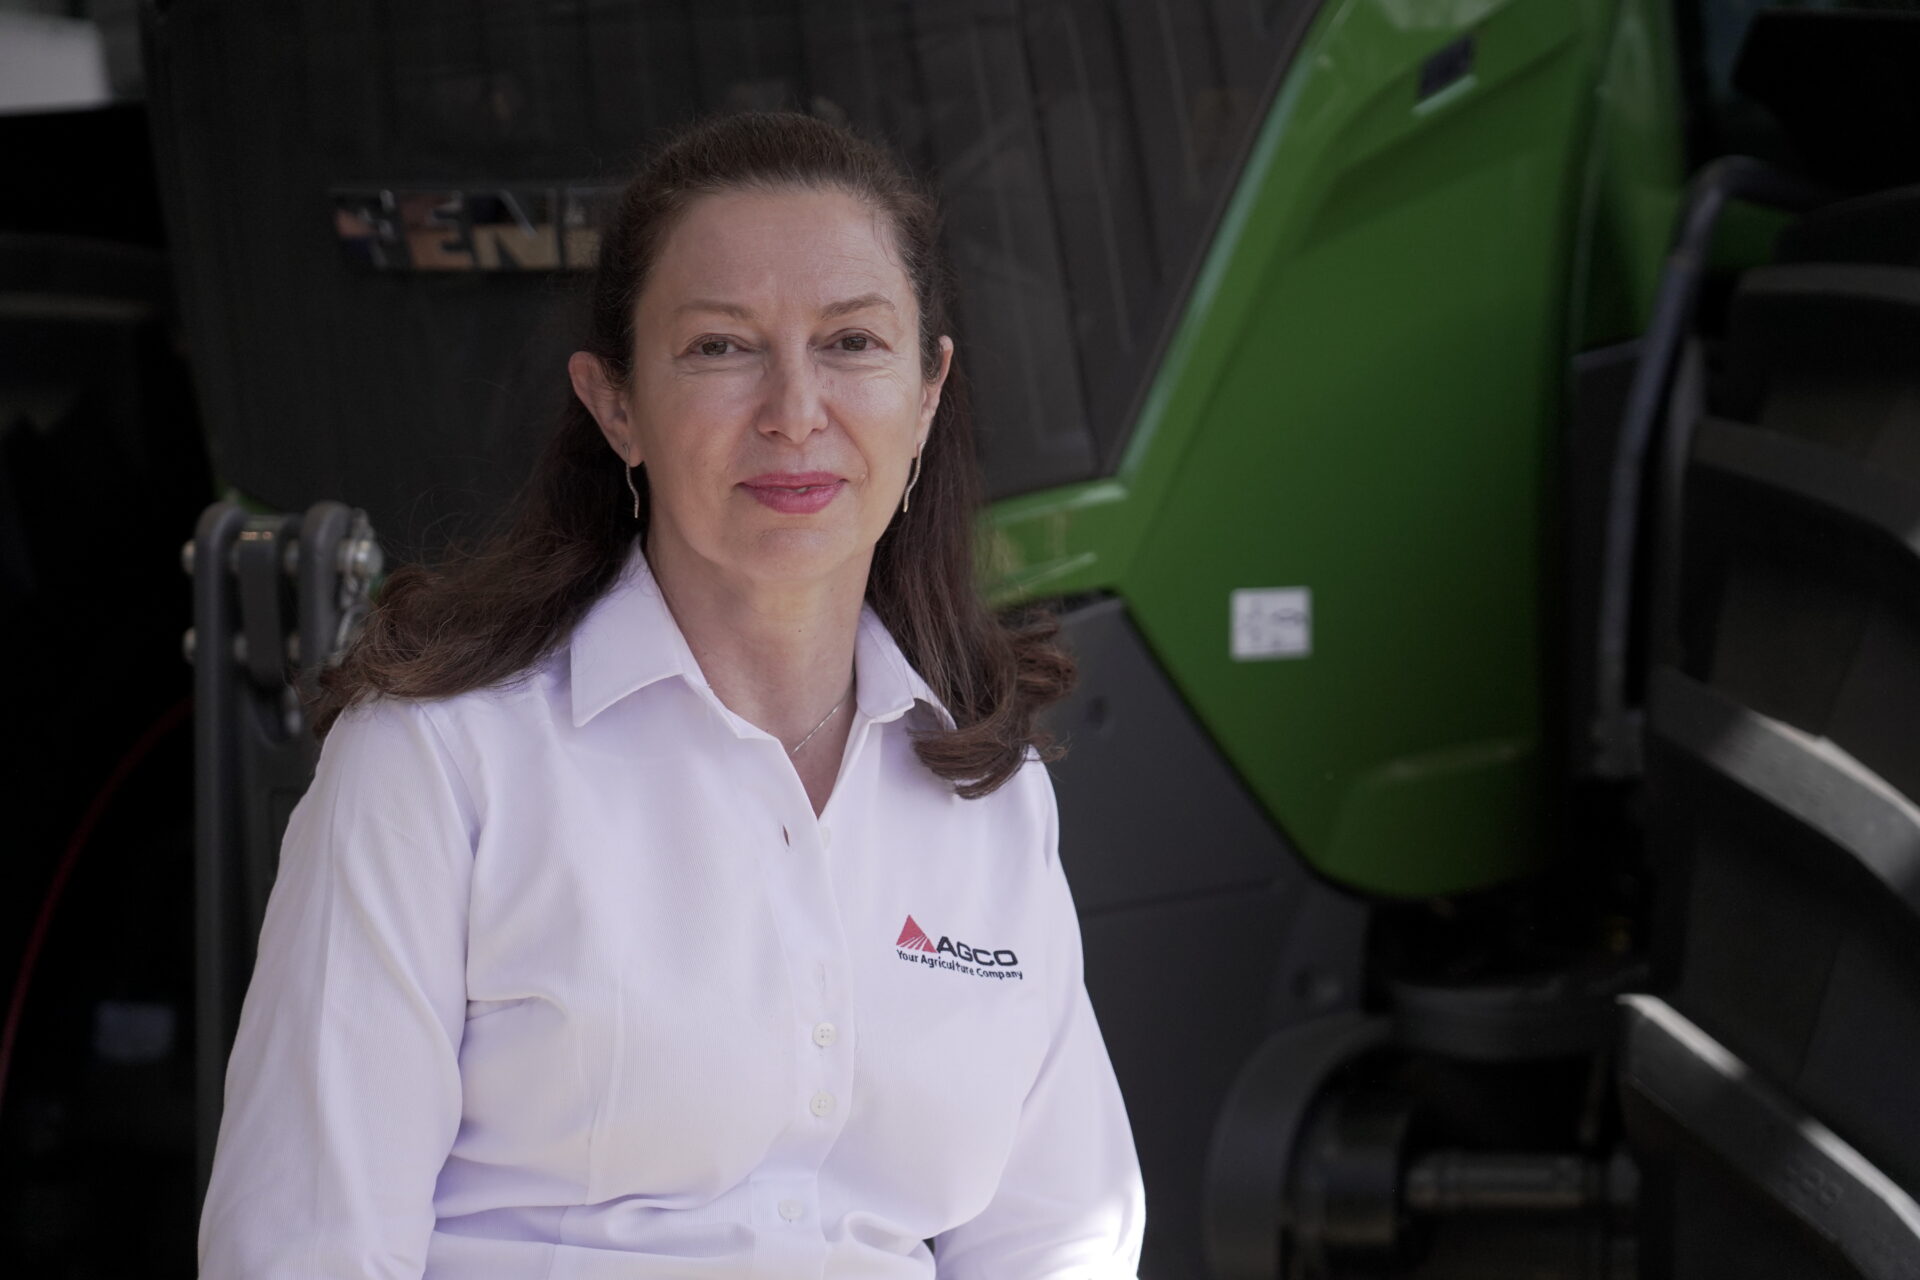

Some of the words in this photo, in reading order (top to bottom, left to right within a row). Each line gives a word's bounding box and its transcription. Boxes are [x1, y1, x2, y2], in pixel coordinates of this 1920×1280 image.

[896, 949, 918, 963] Your
[920, 954, 974, 976] Agriculture
[976, 967, 1023, 980] Company
[936, 936, 1018, 966] AGCO
